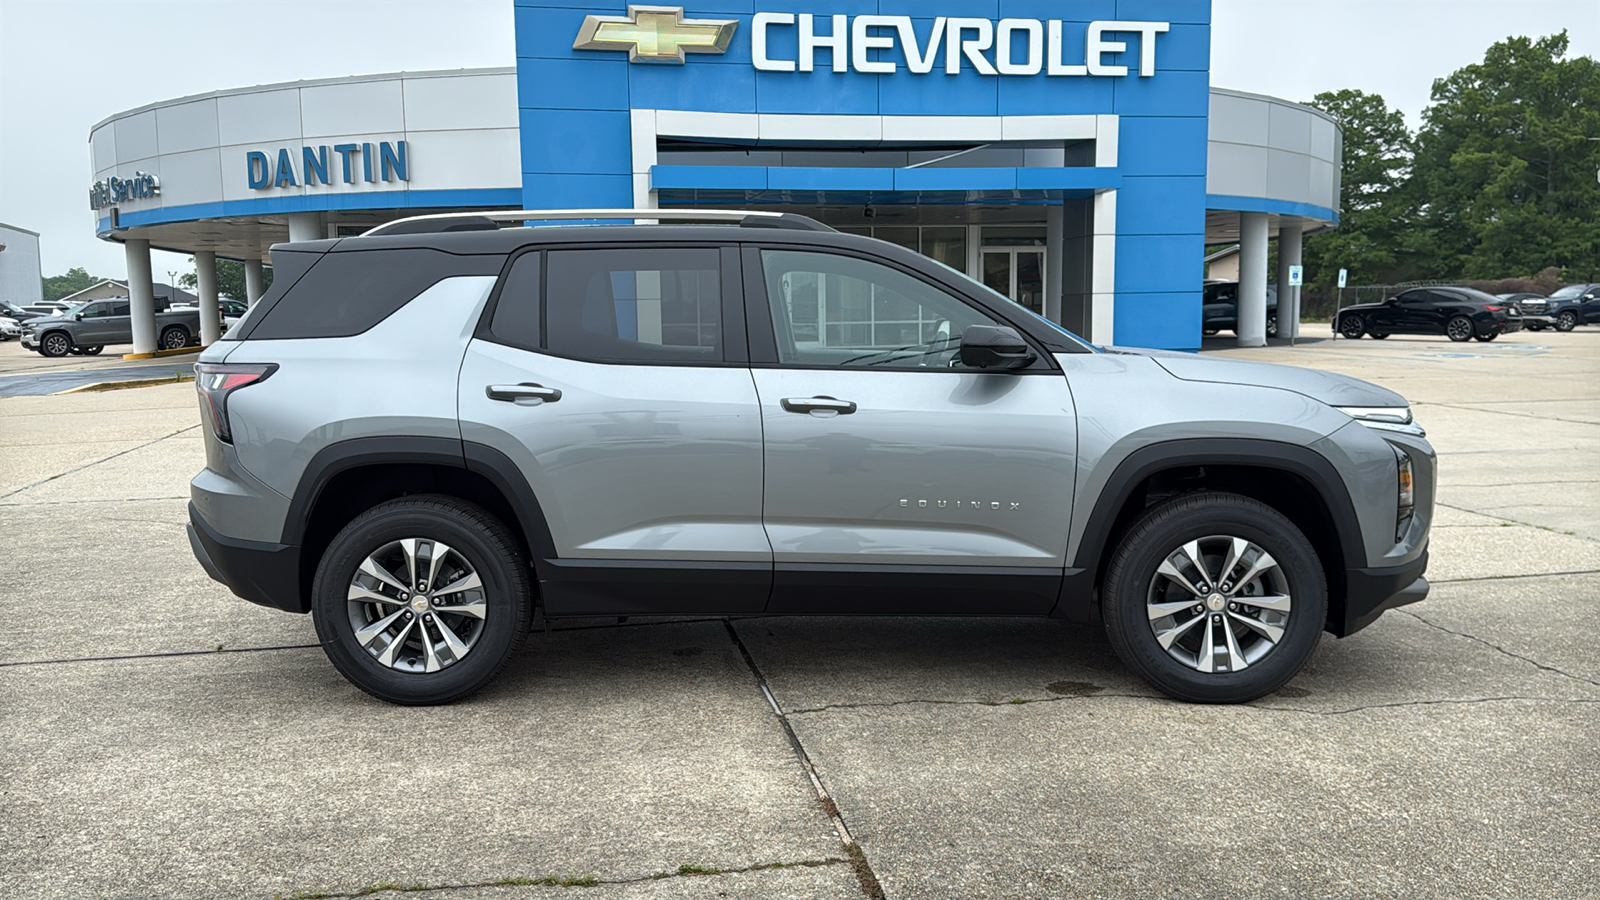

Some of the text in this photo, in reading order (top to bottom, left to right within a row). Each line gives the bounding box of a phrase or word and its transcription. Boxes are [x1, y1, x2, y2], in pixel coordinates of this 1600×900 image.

[751, 12, 1170, 78] CHEVROLET
[246, 140, 409, 190] DANTIN
[110, 171, 159, 203] Service
[899, 499, 1020, 511] EQUINOX
